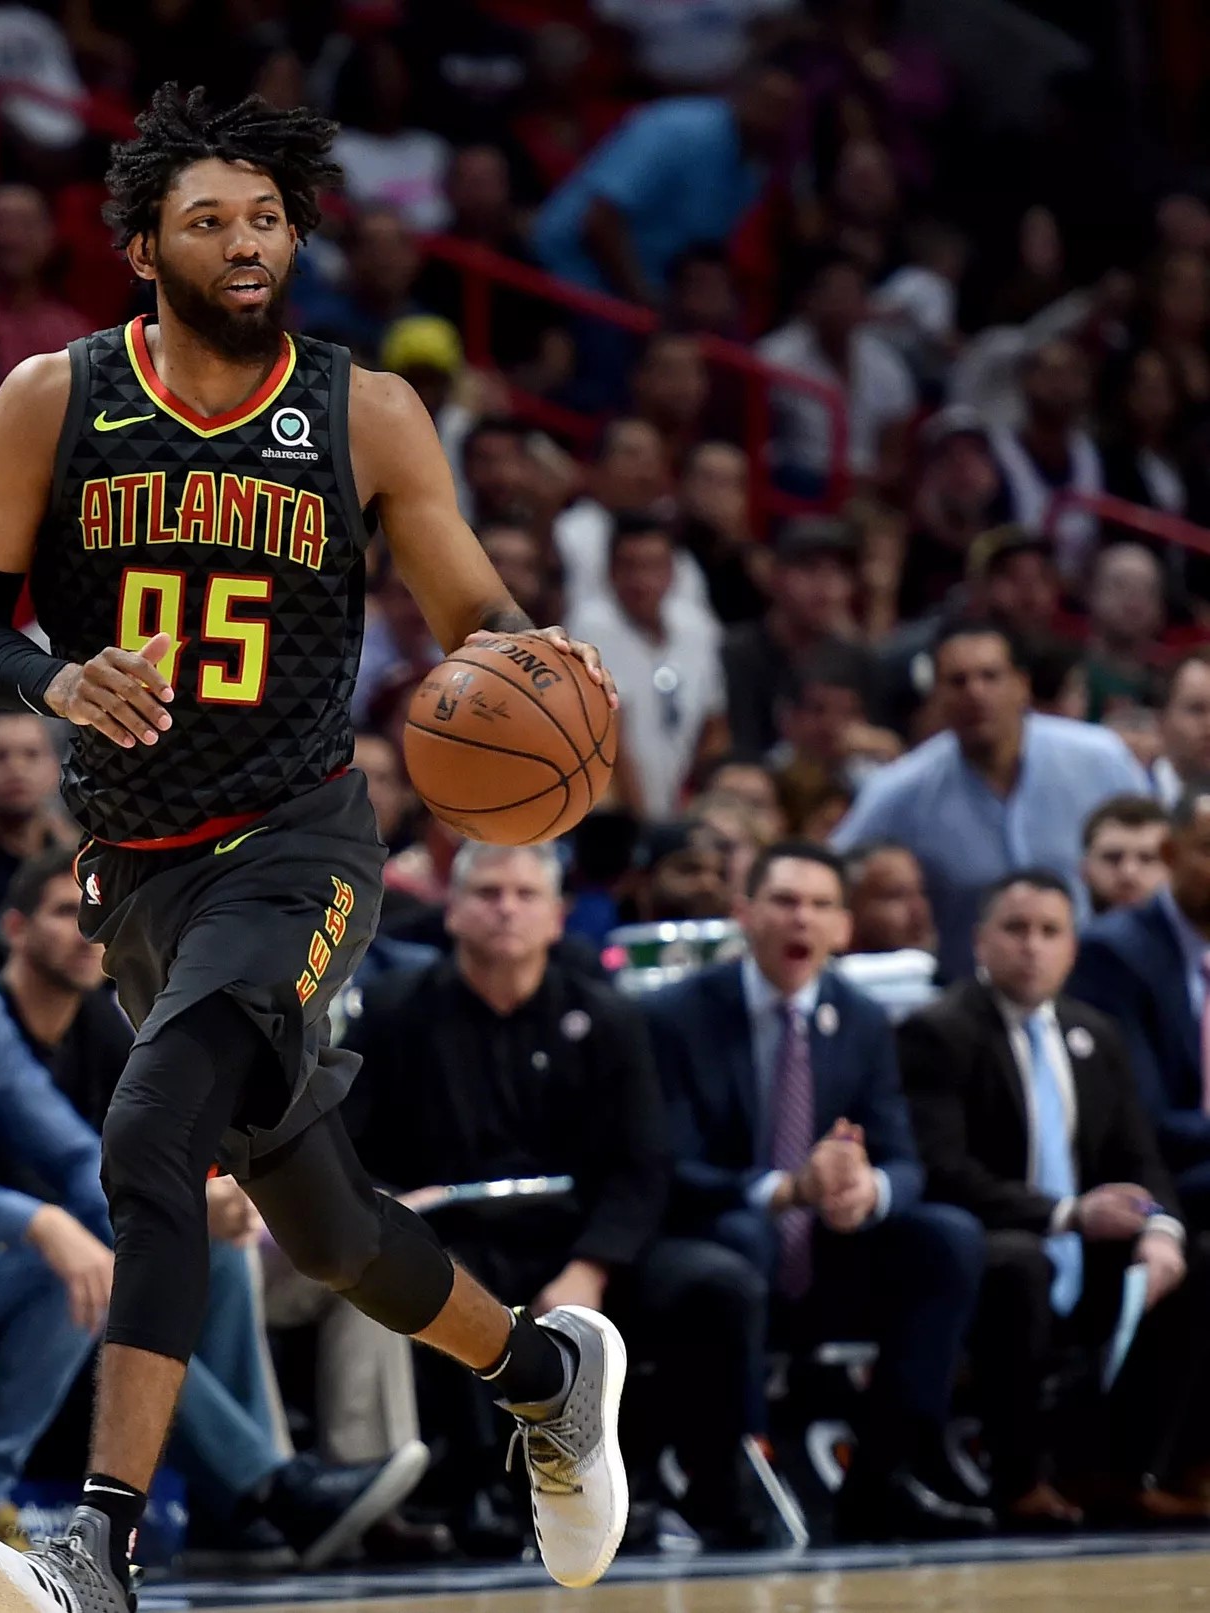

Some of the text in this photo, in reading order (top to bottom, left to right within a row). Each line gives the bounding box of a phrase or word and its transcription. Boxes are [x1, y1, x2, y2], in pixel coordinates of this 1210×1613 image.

[261, 447, 319, 461] sharecare
[79, 471, 329, 571] ATLANTA
[116, 567, 273, 706] 95
